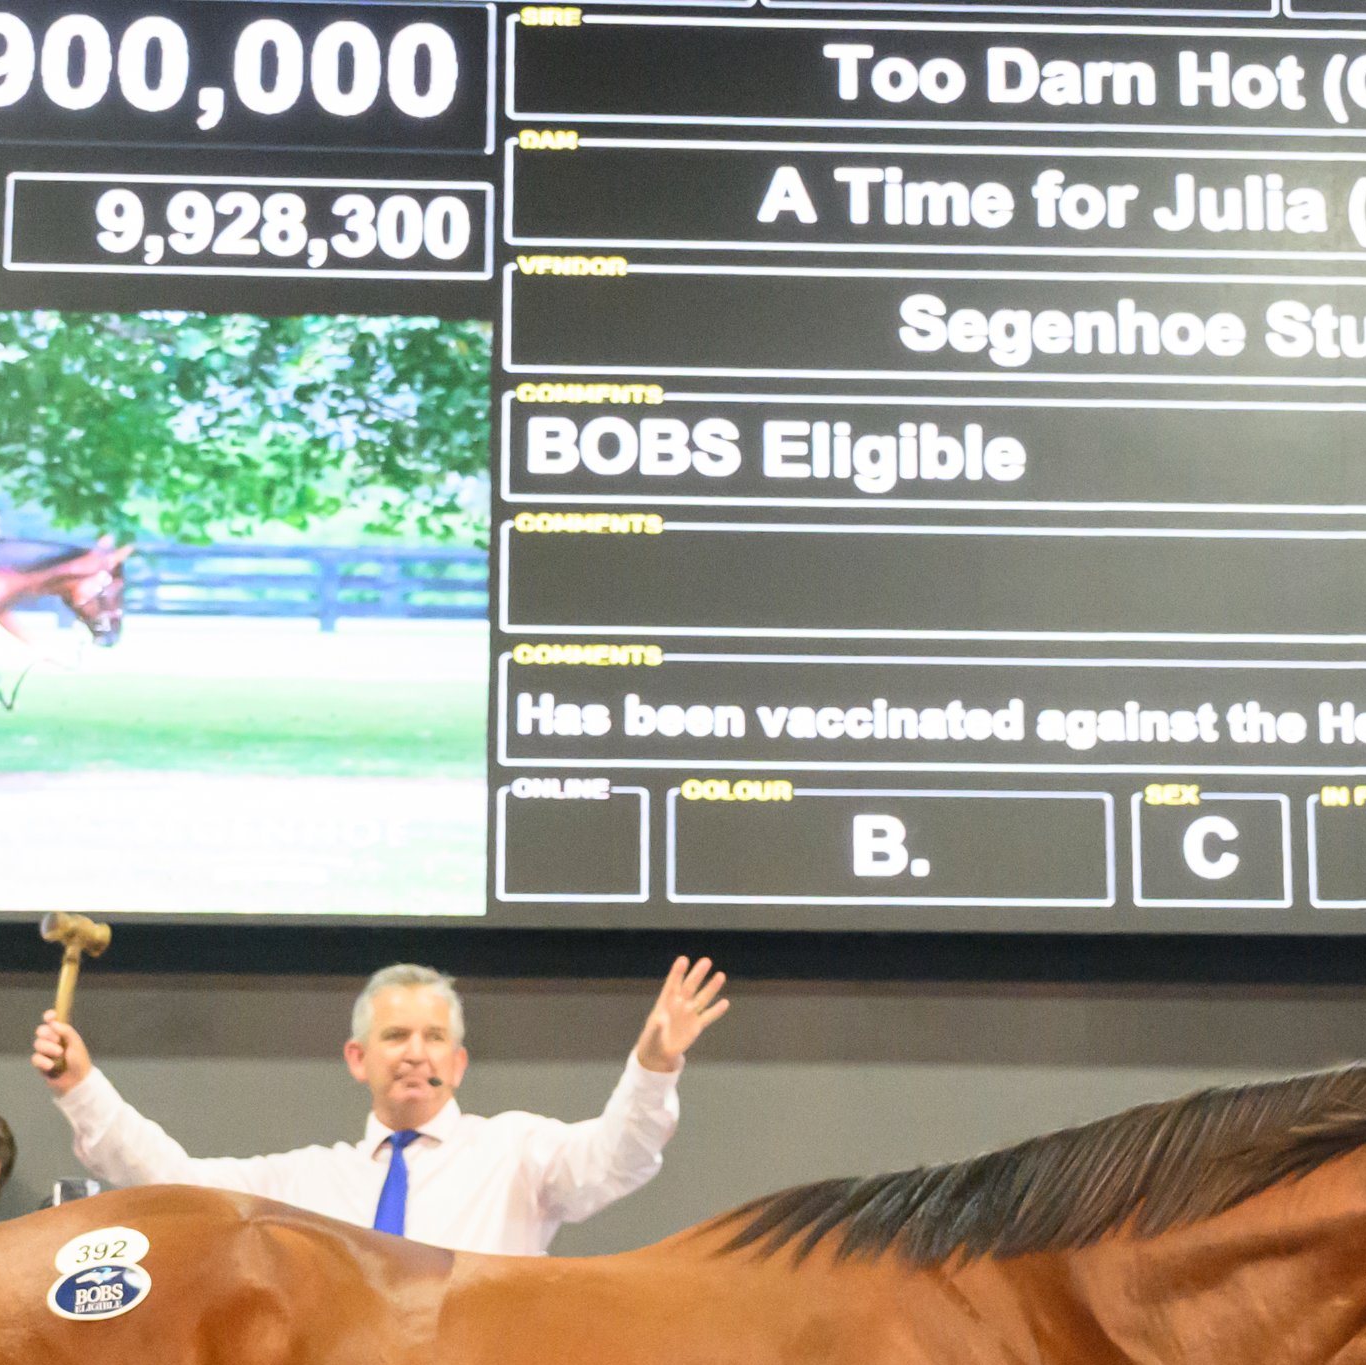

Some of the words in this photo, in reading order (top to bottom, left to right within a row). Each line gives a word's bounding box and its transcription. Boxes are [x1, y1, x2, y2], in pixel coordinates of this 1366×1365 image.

[520, 7, 582, 26] SIRE
[823, 43, 966, 104] Too
[987, 47, 1156, 106] Darn
[1178, 50, 1306, 110] Hot
[519, 130, 579, 149] DAM
[757, 166, 818, 224] A
[833, 166, 1015, 229] Time
[1031, 169, 1139, 230] for
[1153, 173, 1329, 235] Julia
[96, 189, 470, 267] 9,928,300
[517, 256, 628, 276] VENDOR
[899, 293, 1247, 368] Segenhoe
[516, 383, 664, 404] COMMENTS
[527, 416, 742, 477] BOBS
[763, 420, 1027, 494] Eligible
[514, 512, 664, 534] COMMENTS
[513, 643, 663, 666] COMMENTS
[517, 692, 612, 736] Has
[624, 693, 746, 738] been
[756, 698, 1025, 741] vaccinated
[1036, 700, 1220, 750] against
[1226, 700, 1308, 744] the
[511, 777, 611, 800] ONLINE
[681, 779, 793, 801] COLOUR
[1145, 784, 1201, 805] SEX
[1320, 785, 1350, 807] IN
[852, 814, 930, 877] B.
[1183, 815, 1239, 880] C
[76, 1240, 127, 1263] 392
[75, 1283, 123, 1306] BOBS
